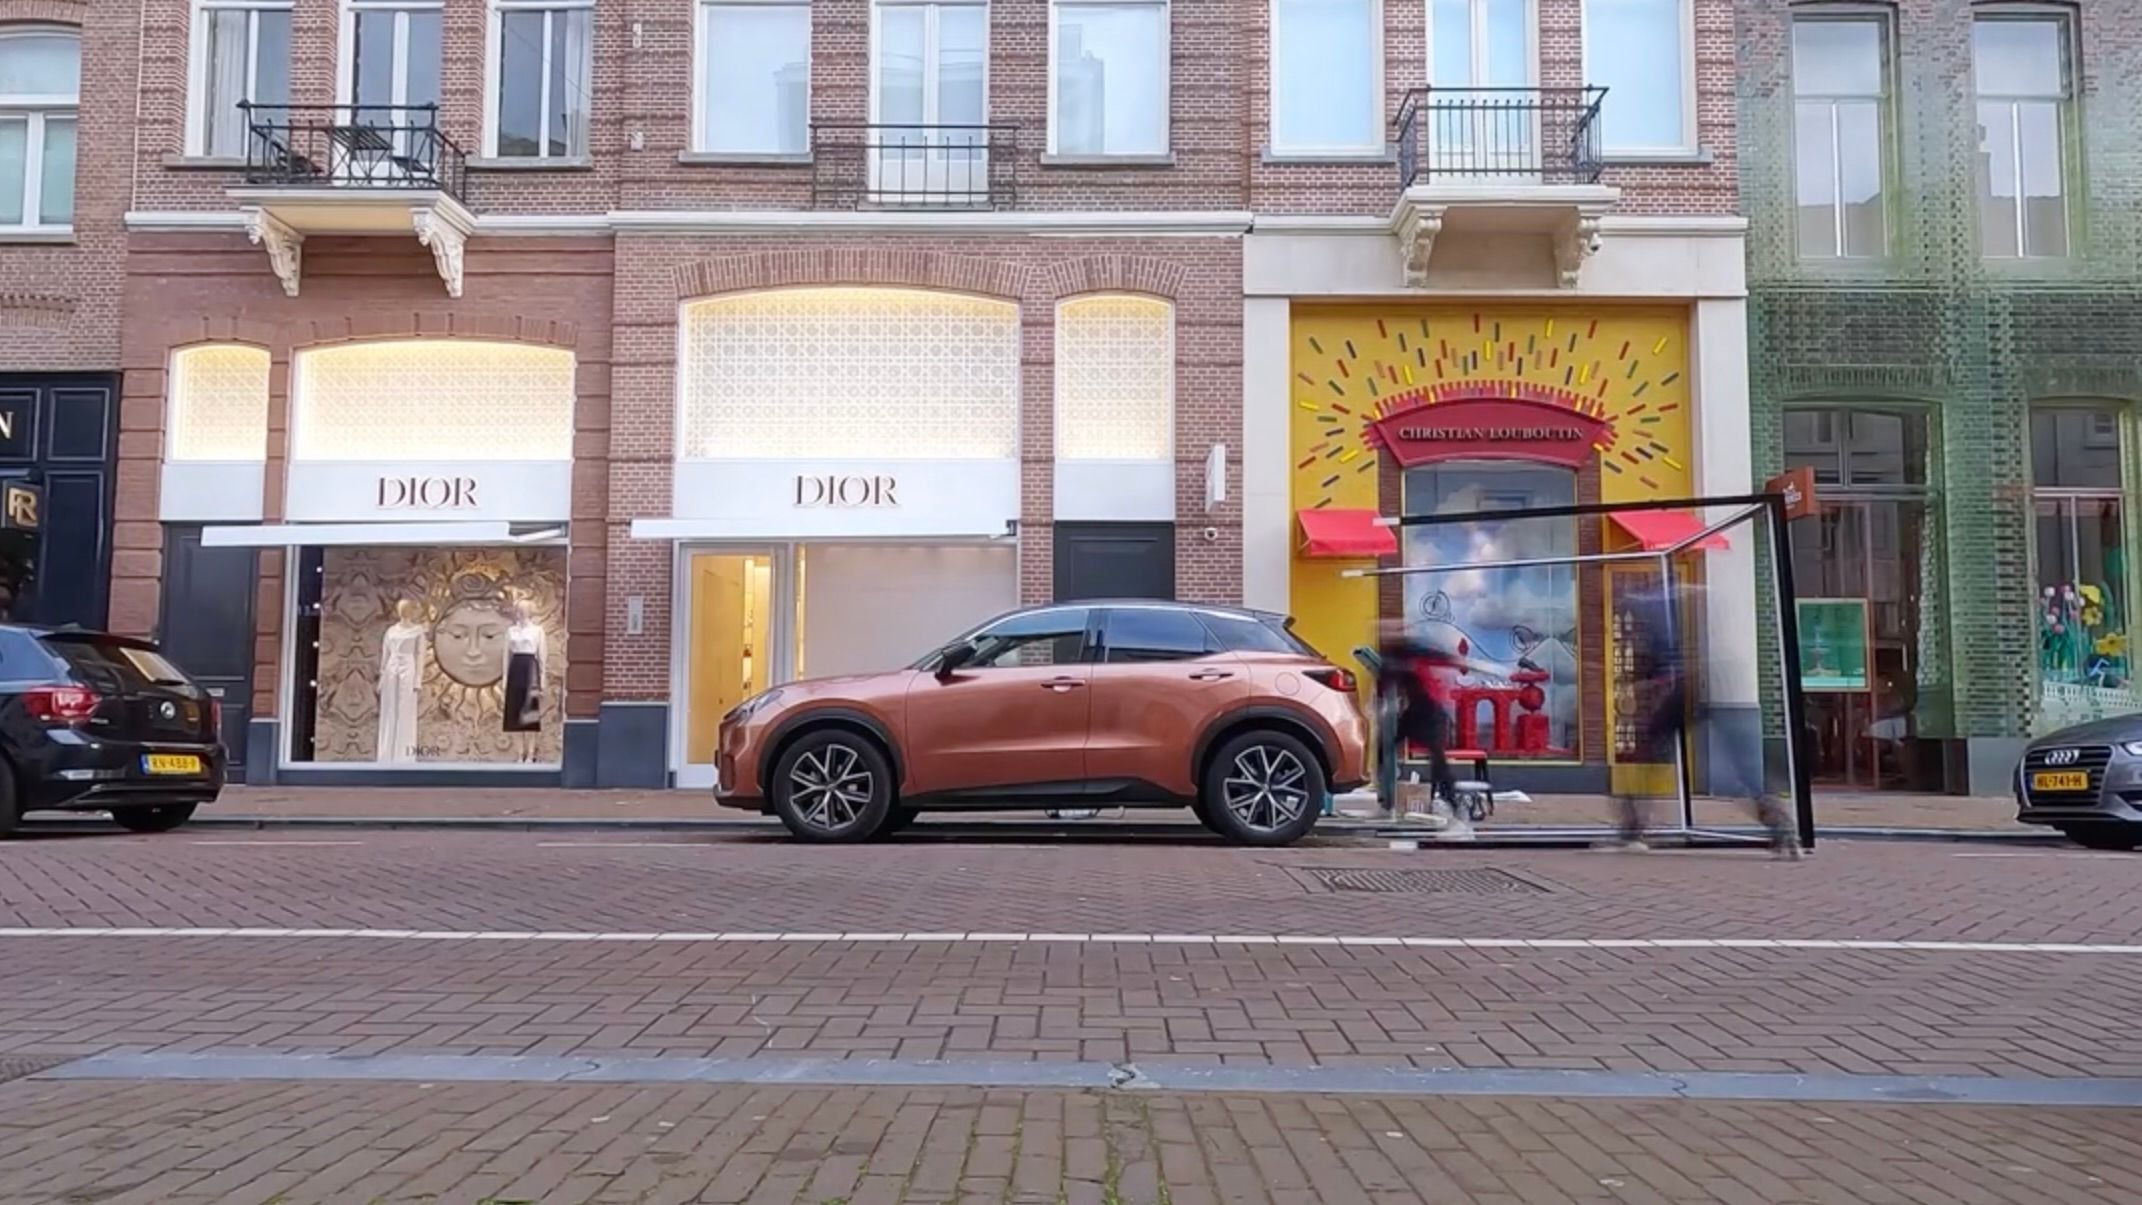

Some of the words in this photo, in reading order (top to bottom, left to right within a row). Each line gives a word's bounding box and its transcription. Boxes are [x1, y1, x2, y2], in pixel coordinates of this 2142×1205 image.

[1399, 427, 1485, 440] CHRISTIAN
[1489, 427, 1585, 440] LOUBOUTIN
[377, 476, 480, 507] DIOR
[794, 475, 900, 505] DIOR
